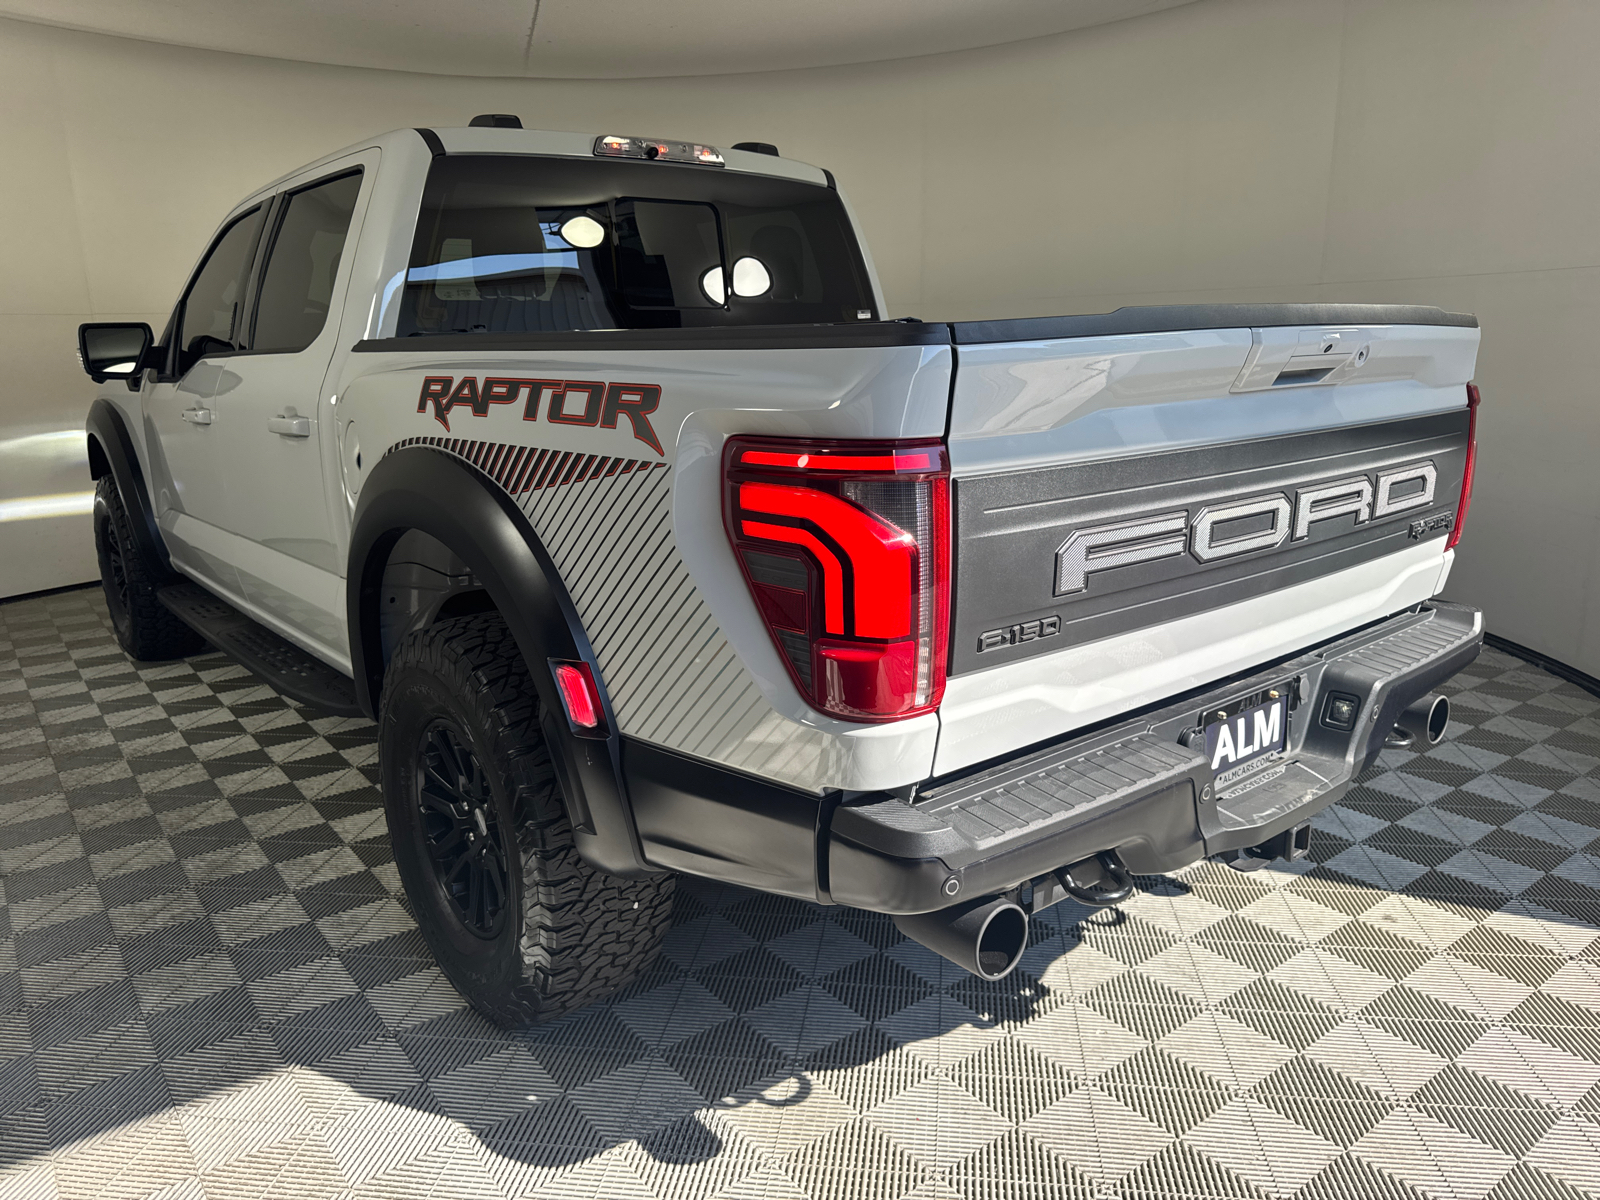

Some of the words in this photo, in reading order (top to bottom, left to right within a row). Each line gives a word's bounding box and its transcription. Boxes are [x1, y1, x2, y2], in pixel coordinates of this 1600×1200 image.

[417, 376, 664, 457] RAPTOR
[1053, 459, 1437, 597] FORD
[1408, 510, 1453, 541] RAPTOR
[977, 615, 1061, 654] F-150
[1211, 702, 1281, 770] ALM
[1222, 756, 1271, 785] ALMCARS.COM
